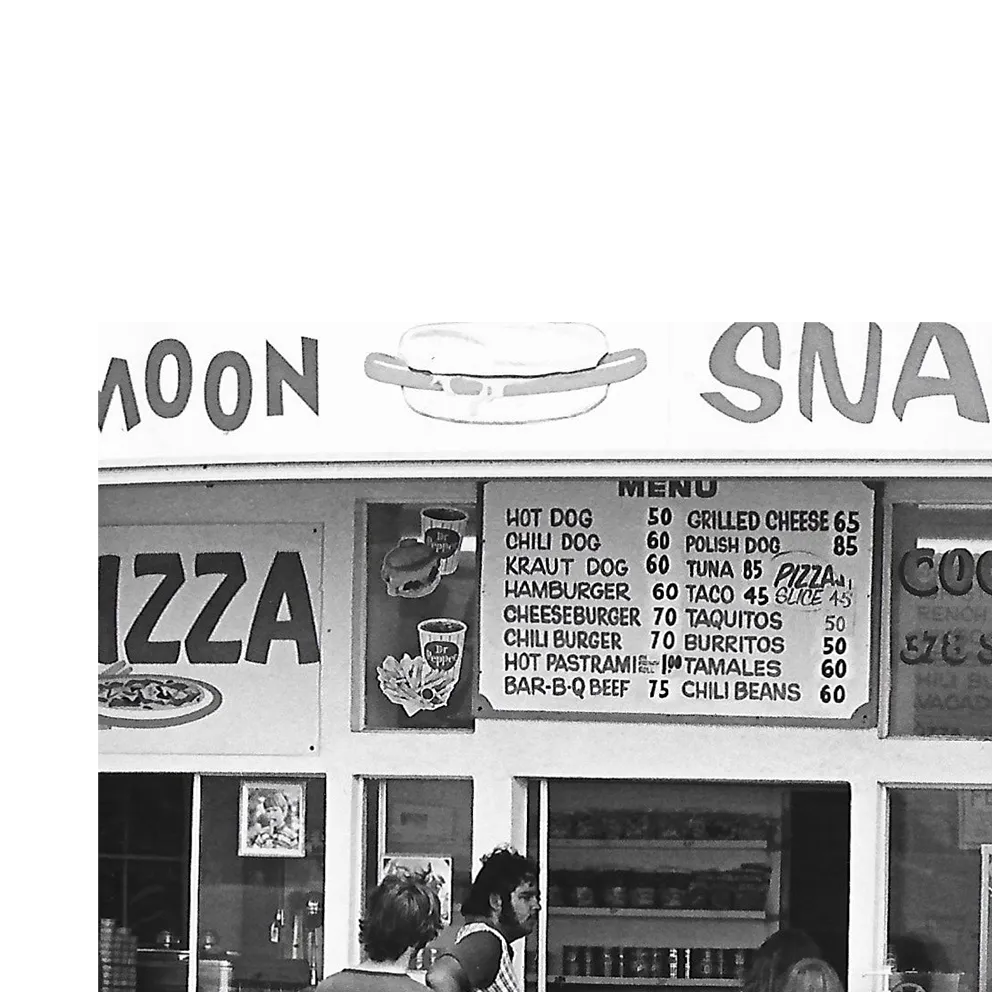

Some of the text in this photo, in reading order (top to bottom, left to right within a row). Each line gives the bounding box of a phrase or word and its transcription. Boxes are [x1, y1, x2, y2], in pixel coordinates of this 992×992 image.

[618, 480, 718, 498] MENU
[506, 507, 672, 528] HOT DOG 50
[687, 510, 860, 533] GRILLED CHEESE 65
[505, 531, 670, 551] CHILI DOG 60
[686, 535, 858, 556] POLISH DOG 85
[505, 554, 669, 577] KRAUT DOG 60
[686, 559, 762, 580] TUNA 85
[505, 580, 678, 601] HAMBURGER 60
[685, 585, 769, 605] TACO 45
[775, 586, 824, 606] SLICE
[503, 605, 677, 627] CHEESEBURGER 70
[685, 608, 846, 632] TAQUITOS 50
[436, 644, 449, 654] Dr
[503, 628, 675, 650] CHILI BURGER 70
[684, 634, 847, 655] BURRITOS 50
[504, 653, 541, 671] HOT
[546, 653, 637, 674] PASTRAMI
[684, 657, 847, 678] TAMALES 60
[504, 675, 669, 699] BAR-B-Q BEEF 75
[681, 680, 846, 704] CHILI BEANS 60
